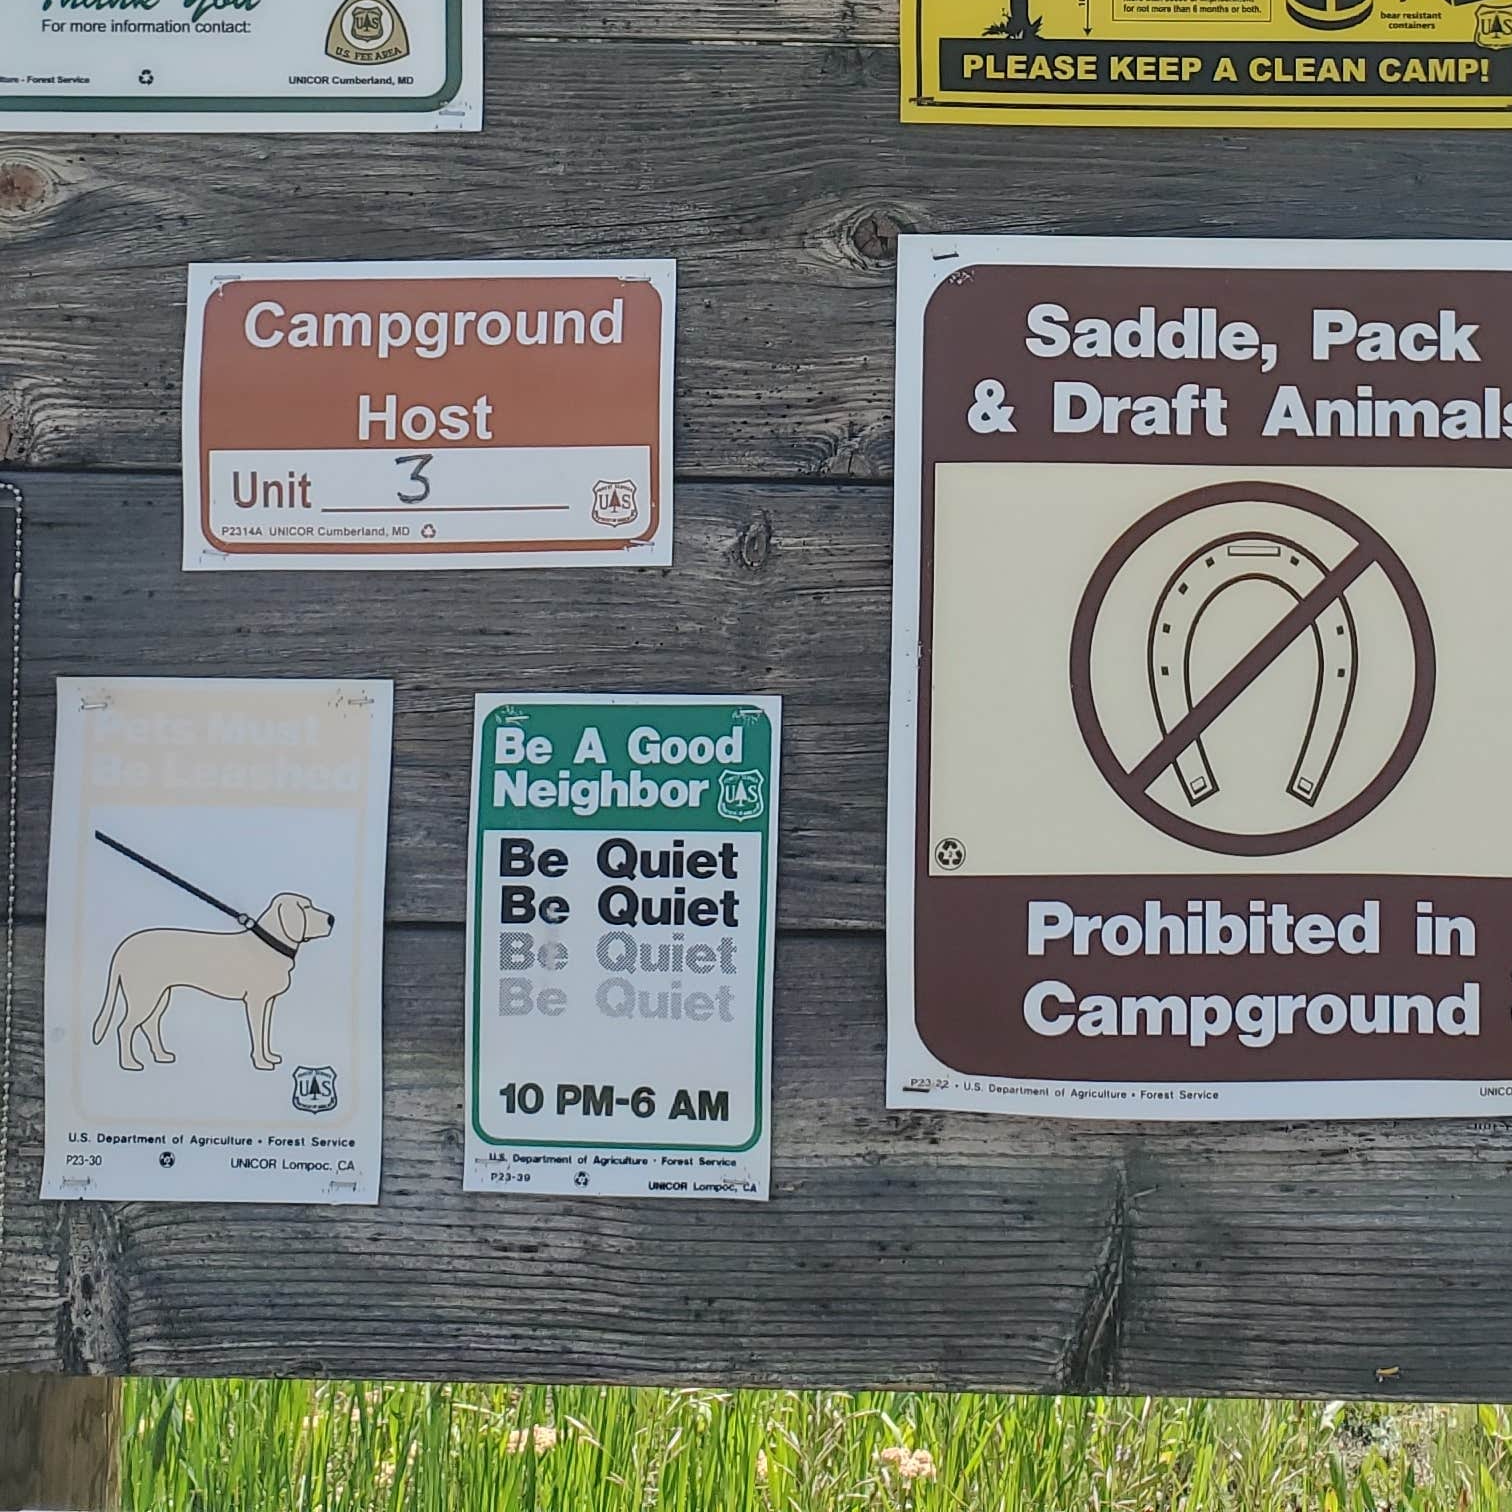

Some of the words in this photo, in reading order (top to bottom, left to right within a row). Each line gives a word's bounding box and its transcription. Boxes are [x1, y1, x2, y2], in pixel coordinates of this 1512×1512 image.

[354, 51, 374, 61] FEE
[963, 54, 1098, 80] PLEASE
[1110, 56, 1202, 81] KEEP
[1213, 57, 1238, 82] A
[1249, 57, 1366, 82] CLEAN
[1378, 57, 1489, 83] CAMP!
[288, 75, 330, 85] UNICOR
[397, 76, 414, 85] MD
[244, 296, 625, 359] Campground
[1024, 301, 1279, 373] Saddle,
[1311, 307, 1482, 362] Pack
[358, 392, 493, 441] Host
[966, 377, 1017, 434] &
[1053, 379, 1228, 437] Draft
[232, 470, 312, 509] Unit
[394, 453, 434, 505] 3
[221, 526, 263, 537] P2314A
[269, 526, 314, 537] UNICOR
[391, 526, 410, 536] MD
[494, 724, 553, 764] Be
[572, 725, 609, 764] A
[625, 724, 743, 765] Good
[493, 768, 712, 817] Neighbor
[499, 837, 569, 878] Be
[596, 837, 739, 881] Quiet
[500, 885, 570, 925] Be
[597, 884, 740, 928] Quiet
[1027, 899, 1380, 956] Prohibited
[1415, 901, 1476, 957] in
[499, 931, 569, 971] Be
[595, 930, 737, 975] Quiet
[498, 975, 568, 1017] Be
[595, 976, 736, 1023] Quiet
[1023, 978, 1481, 1048] Campground
[499, 1082, 545, 1115] 10
[668, 1089, 729, 1122] AM
[66, 1154, 103, 1166] P23-30
[96, 1132, 166, 1145] Department
[171, 1134, 184, 1145] of
[189, 1135, 253, 1148] Agriculture
[267, 1135, 305, 1147] Forest
[311, 1136, 356, 1148] Service
[230, 1157, 277, 1170] UNICOR
[337, 1160, 355, 1171] CA
